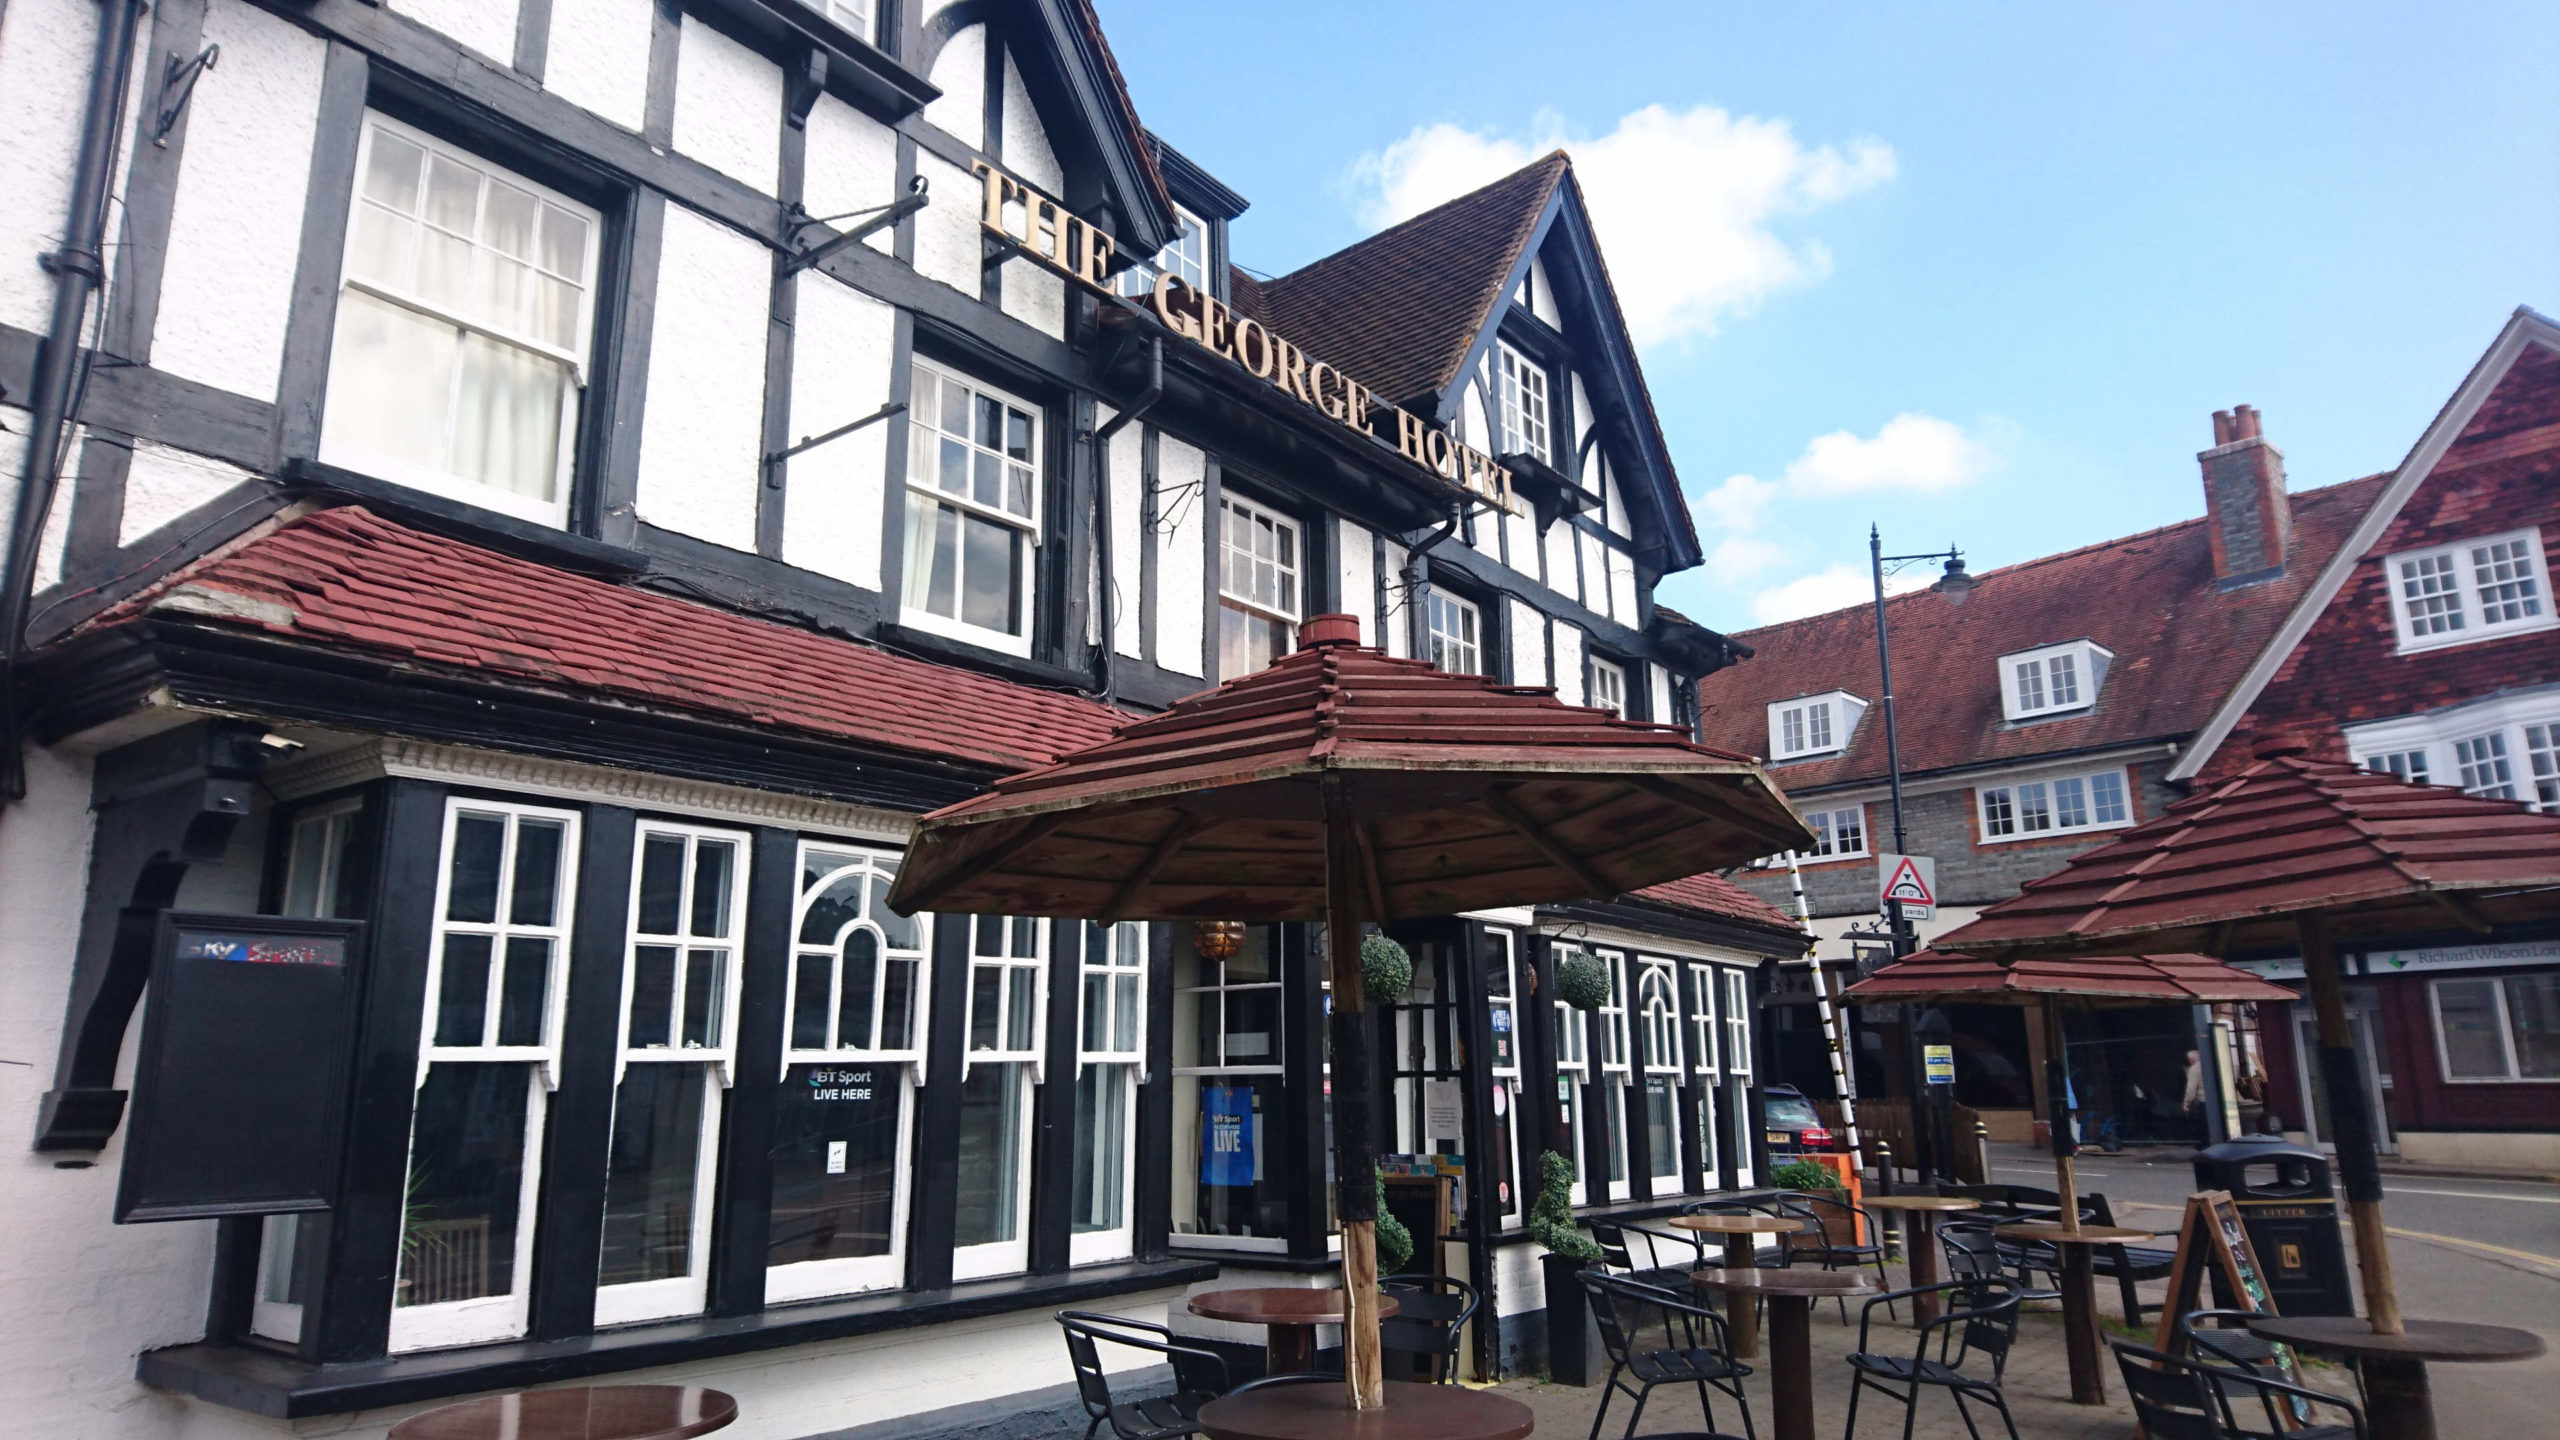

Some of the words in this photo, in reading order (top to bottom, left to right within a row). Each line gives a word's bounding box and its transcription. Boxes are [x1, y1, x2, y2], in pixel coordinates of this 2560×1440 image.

[971, 157, 1117, 300] THE
[1153, 271, 1375, 439] GEORGE
[1392, 404, 1526, 520] HOTEL
[1904, 908, 1926, 916] yards
[2416, 948, 2474, 964] Richard
[2475, 944, 2532, 960] Wilson
[817, 1071, 837, 1083] BT
[838, 1070, 872, 1085] Sport
[814, 1088, 839, 1100] LIVE
[841, 1088, 872, 1100] HERE
[1225, 1114, 1241, 1124] Sport
[1214, 1130, 1241, 1153] LIVE
[2263, 1208, 2306, 1217] LITTER
